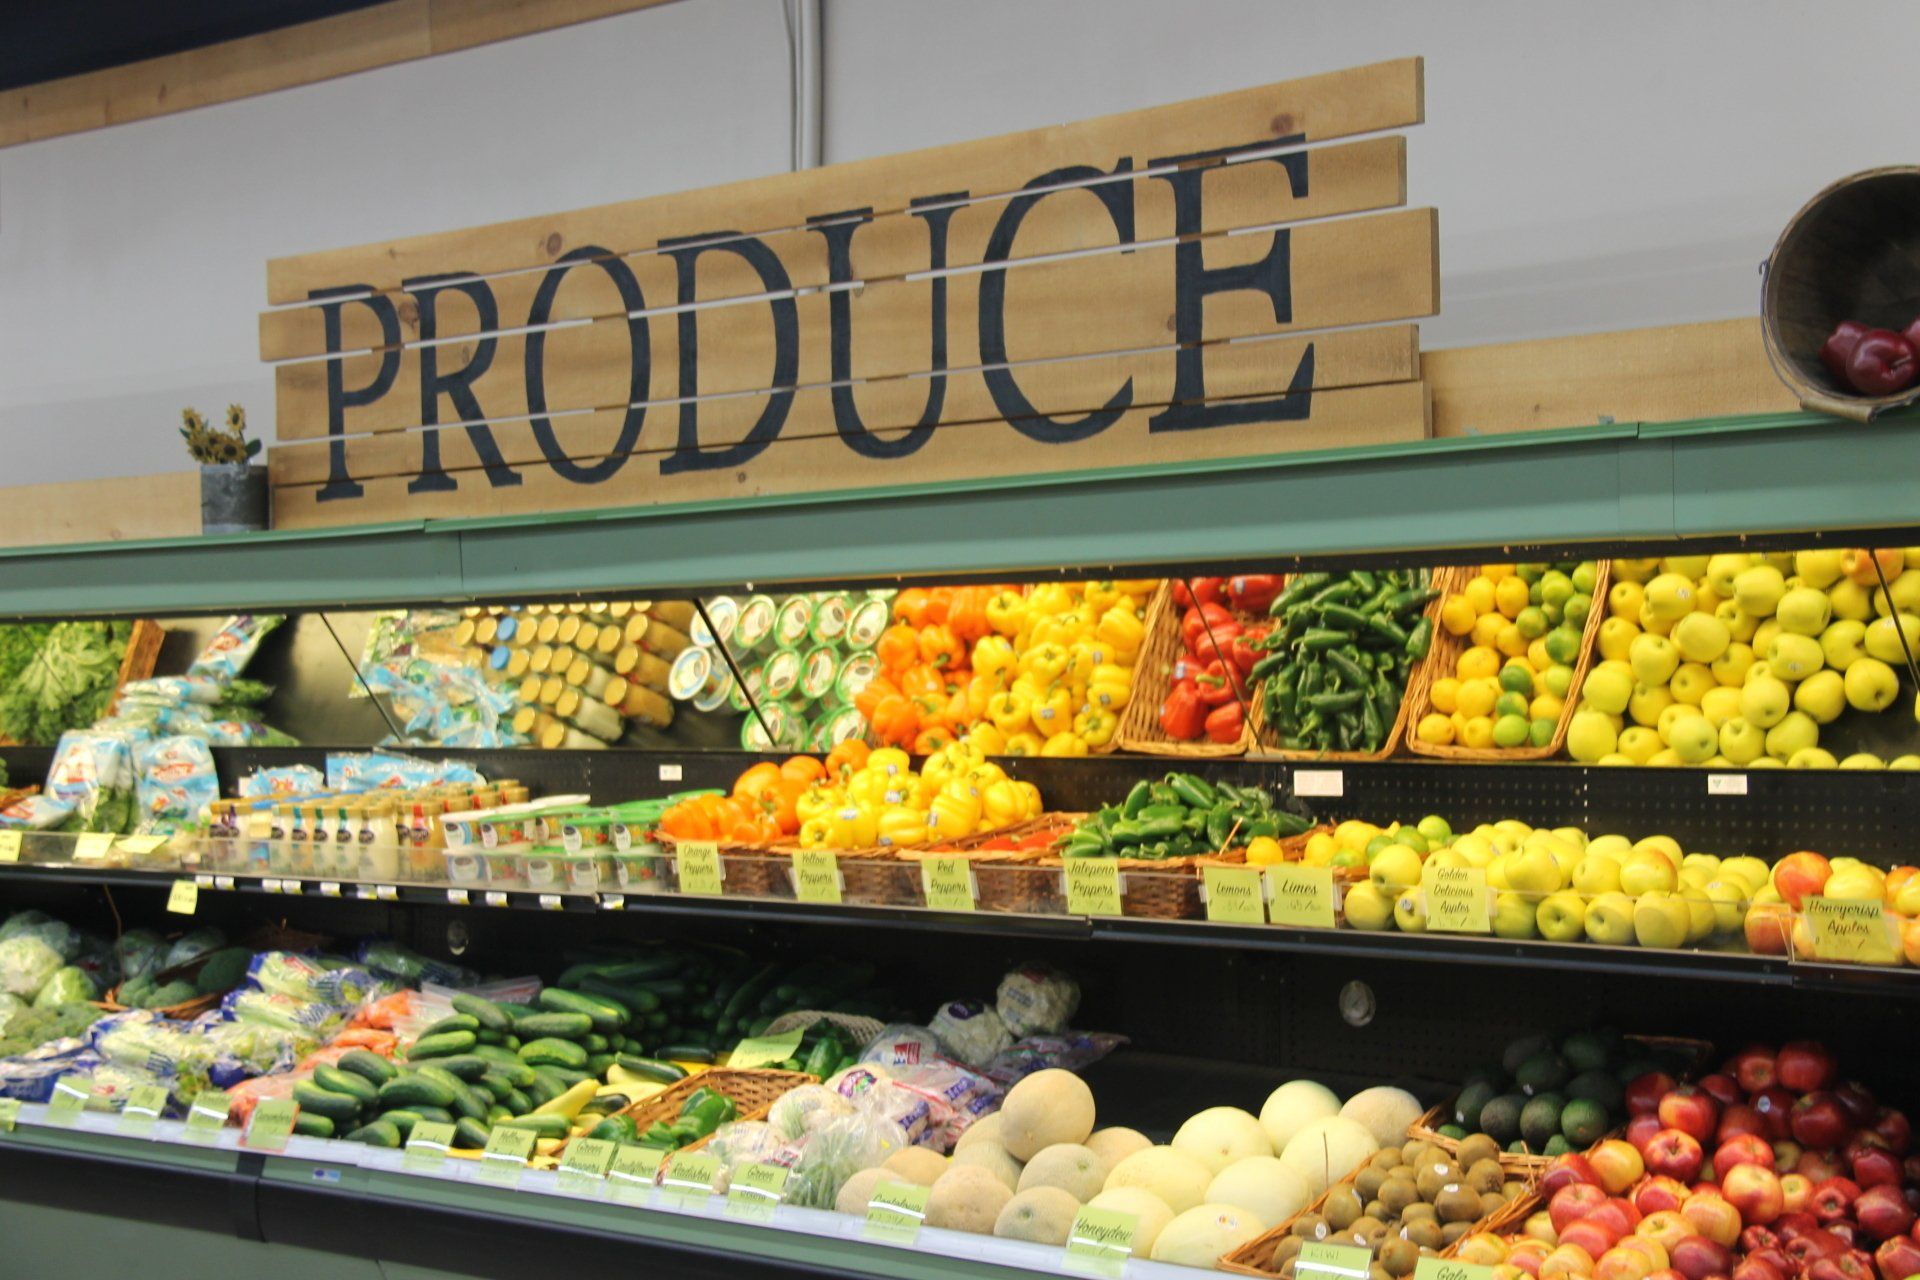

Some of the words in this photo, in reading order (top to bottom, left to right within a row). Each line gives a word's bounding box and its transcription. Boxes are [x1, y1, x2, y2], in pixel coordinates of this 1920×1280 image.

[308, 133, 1315, 502] PRODUCE
[683, 844, 712, 864] Orange
[802, 851, 828, 866] Yellow
[684, 861, 714, 876] Peppers
[937, 860, 955, 874] Red
[1437, 867, 1469, 881] Golden
[800, 870, 833, 885] Peppers
[931, 879, 967, 895] Peppers
[1072, 880, 1113, 897] Peppers
[1216, 881, 1253, 896] Lemons
[1281, 878, 1318, 896] Limes
[1433, 883, 1474, 898] Delicious
[1440, 900, 1470, 916] Apples
[1809, 899, 1880, 920] Honeycrisp
[1827, 919, 1870, 937] Apples
[746, 1164, 776, 1183] Green
[1073, 1215, 1133, 1243] Honeydew
[1436, 1265, 1469, 1280] Gala
